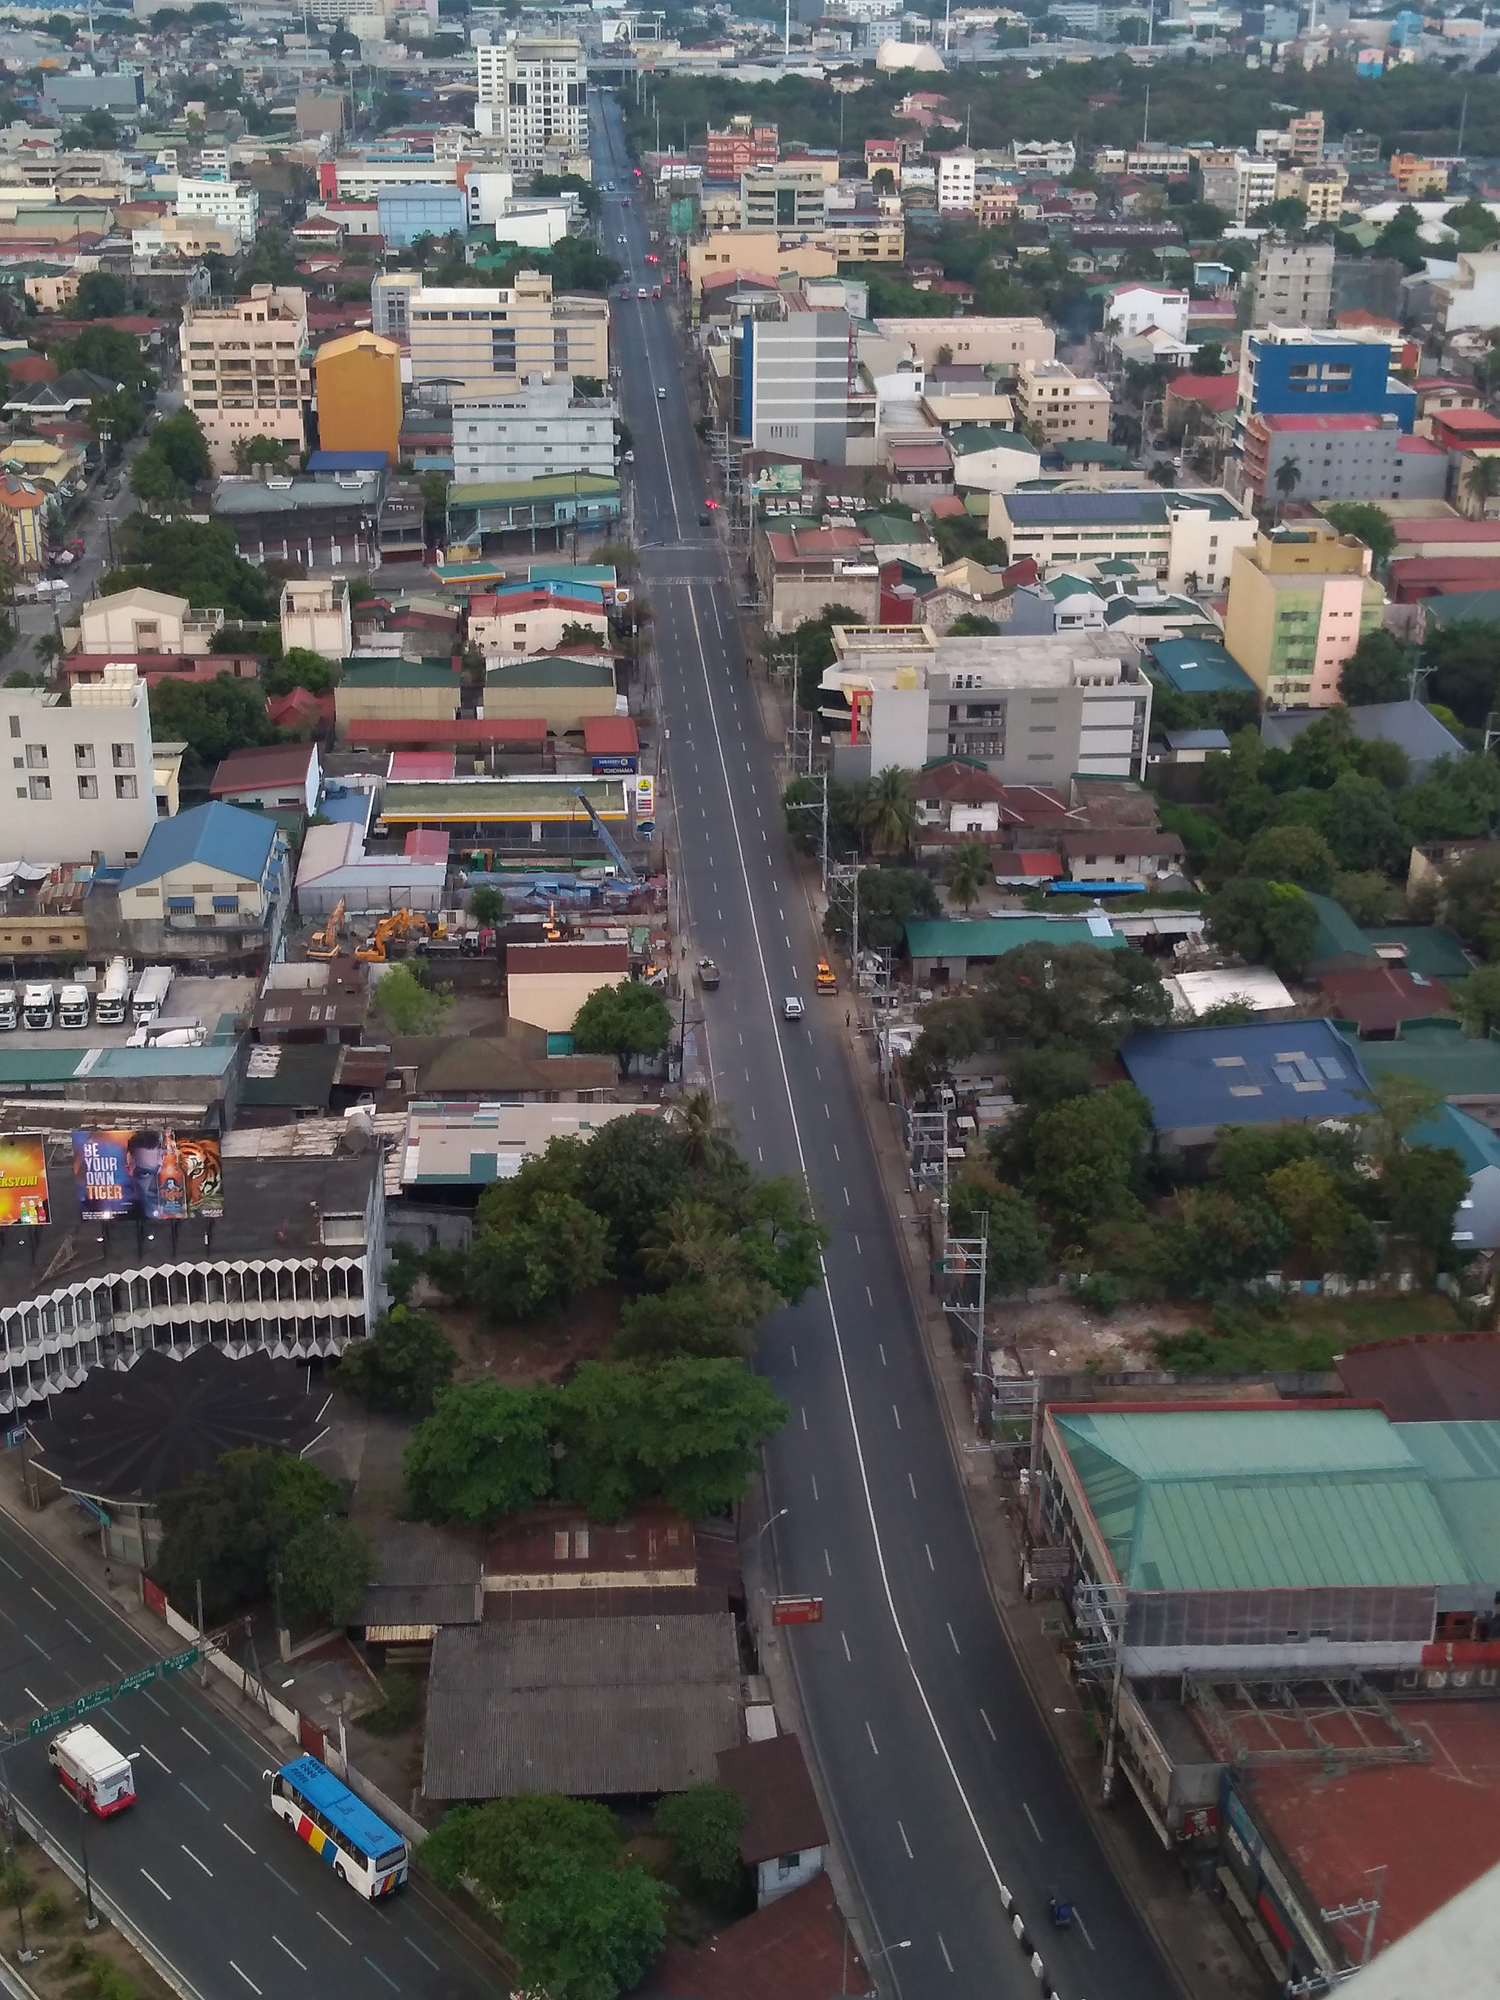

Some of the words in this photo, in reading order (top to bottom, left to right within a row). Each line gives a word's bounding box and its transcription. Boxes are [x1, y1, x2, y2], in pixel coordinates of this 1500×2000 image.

[83, 1143, 100, 1157] BE
[84, 1157, 118, 1172] YOUR
[86, 1171, 115, 1185] OWN
[87, 1185, 123, 1200] TIGER
